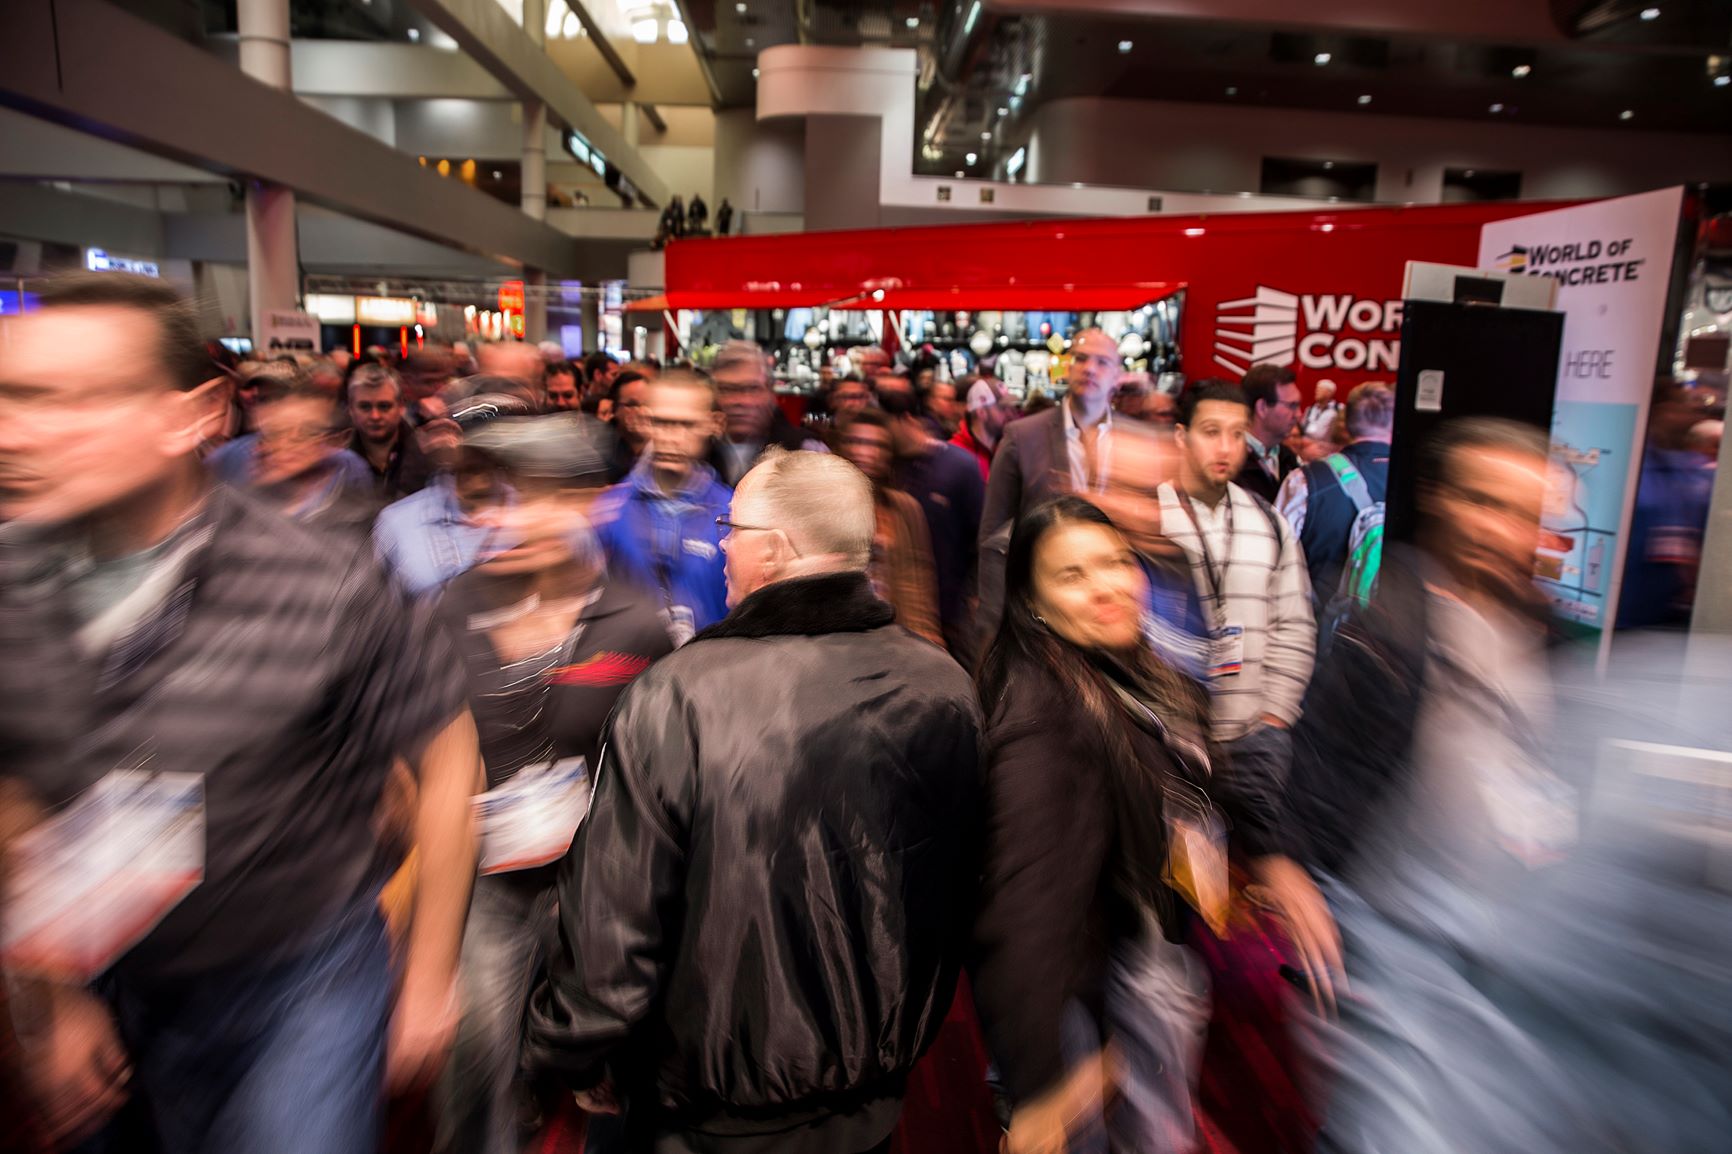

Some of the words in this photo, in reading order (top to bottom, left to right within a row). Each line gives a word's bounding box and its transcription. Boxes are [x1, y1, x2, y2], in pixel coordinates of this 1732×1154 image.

[1529, 240, 1602, 266] WORLD
[1606, 238, 1633, 257] OF
[1528, 260, 1640, 287] NCRETE
[1298, 332, 1401, 370] CON
[1565, 350, 1614, 379] HERE
